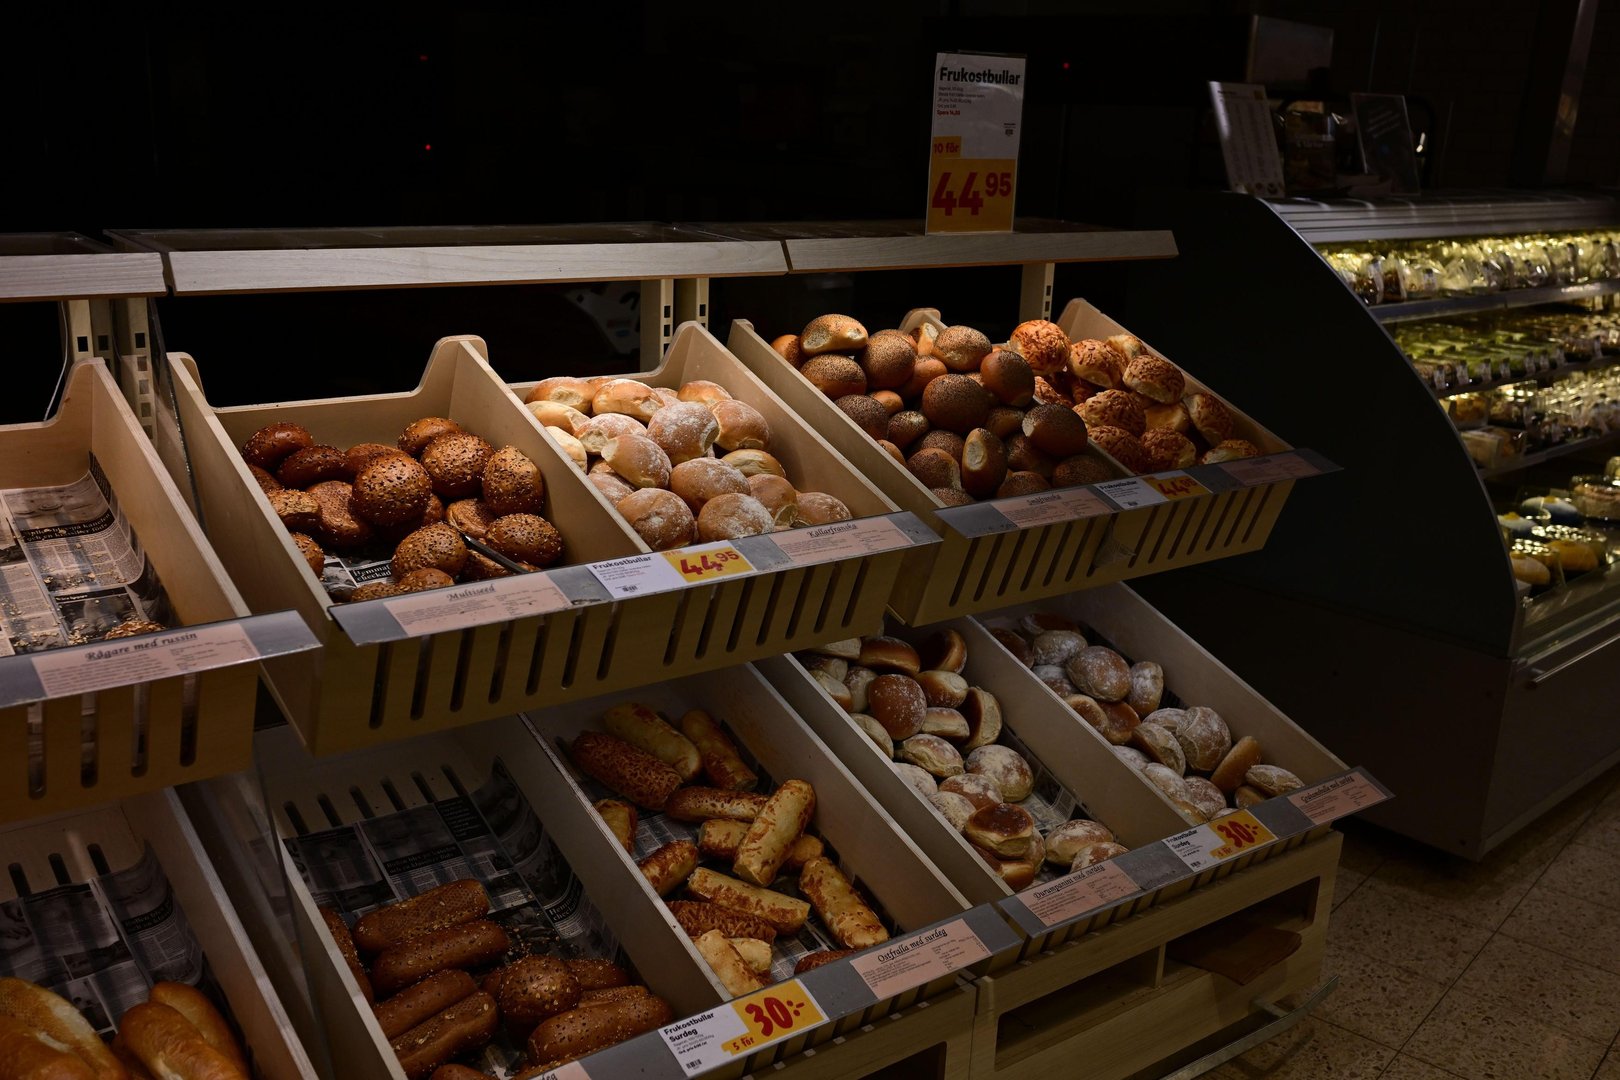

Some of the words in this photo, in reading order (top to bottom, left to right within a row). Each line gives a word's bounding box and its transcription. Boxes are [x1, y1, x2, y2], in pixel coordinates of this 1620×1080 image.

[940, 67, 1020, 85] Frukostbullar
[934, 143, 944, 153] 10
[946, 142, 959, 153] för
[592, 556, 651, 570] Frukostbullar
[447, 584, 496, 600] Multiseed
[85, 646, 130, 661] Rågare
[134, 638, 158, 651] med
[162, 632, 198, 646] russin
[877, 943, 909, 962] Ostfralla
[910, 936, 924, 950] med
[925, 928, 948, 943] surdeg
[663, 1011, 715, 1035] Frukostbullar
[669, 1028, 698, 1043] Surdeg
[732, 1041, 740, 1051] 5
[740, 1036, 756, 1048] för
